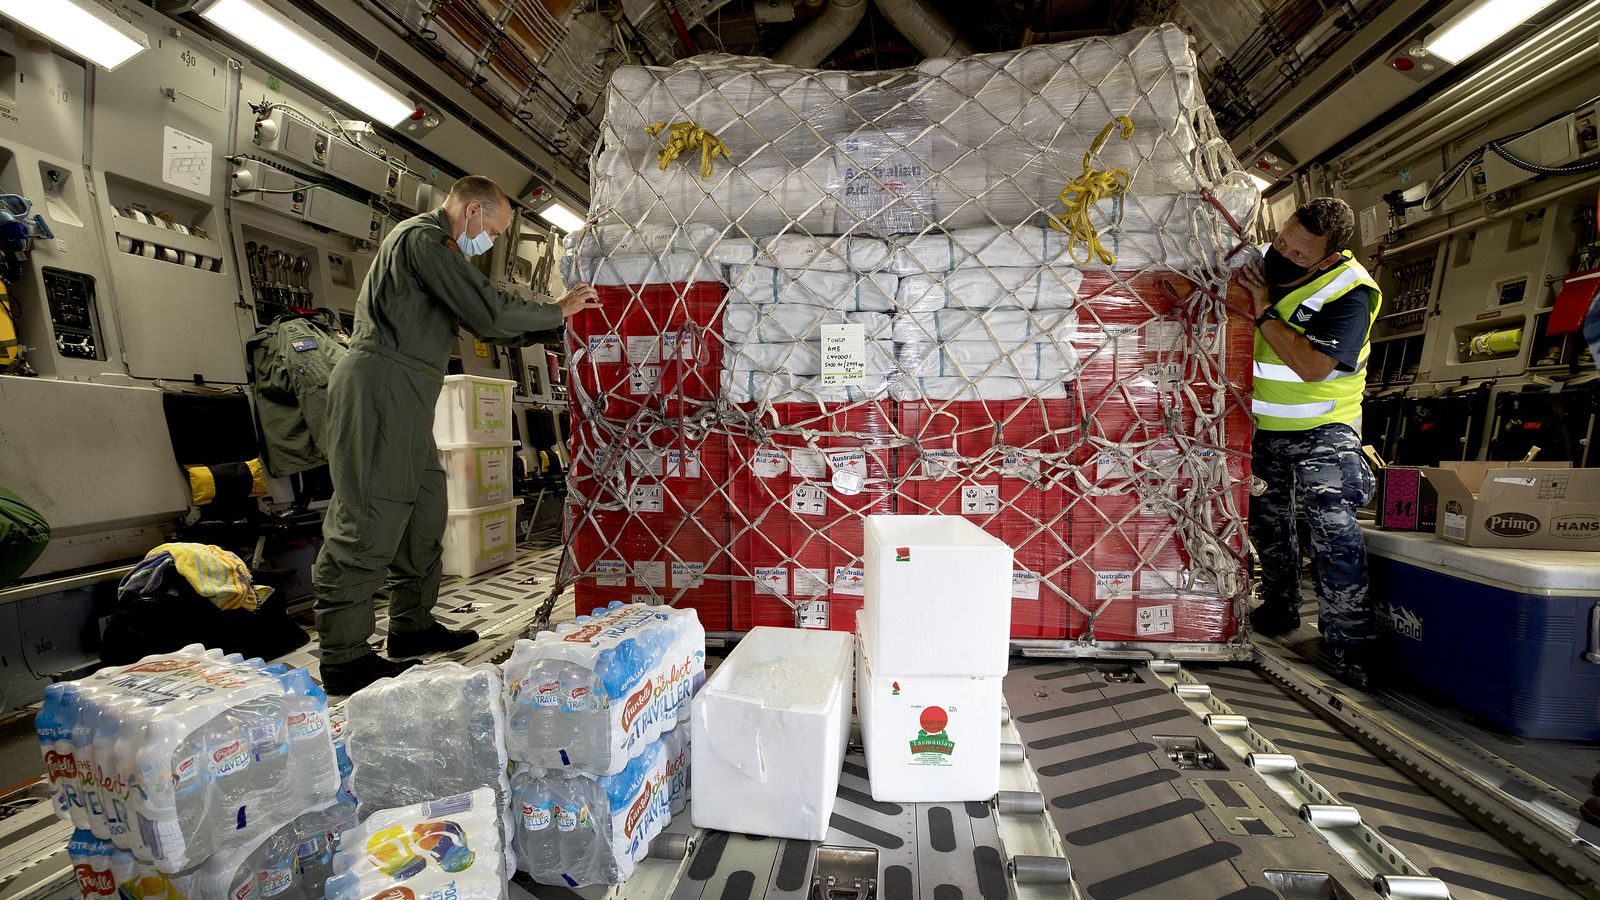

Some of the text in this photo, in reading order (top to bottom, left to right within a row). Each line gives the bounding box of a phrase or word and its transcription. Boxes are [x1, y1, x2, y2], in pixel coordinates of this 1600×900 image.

[181, 52, 196, 67] 430
[832, 454, 864, 462] Australian
[1490, 516, 1538, 532] Primo
[1556, 522, 1600, 531] HANS
[1397, 618, 1421, 640] Cold
